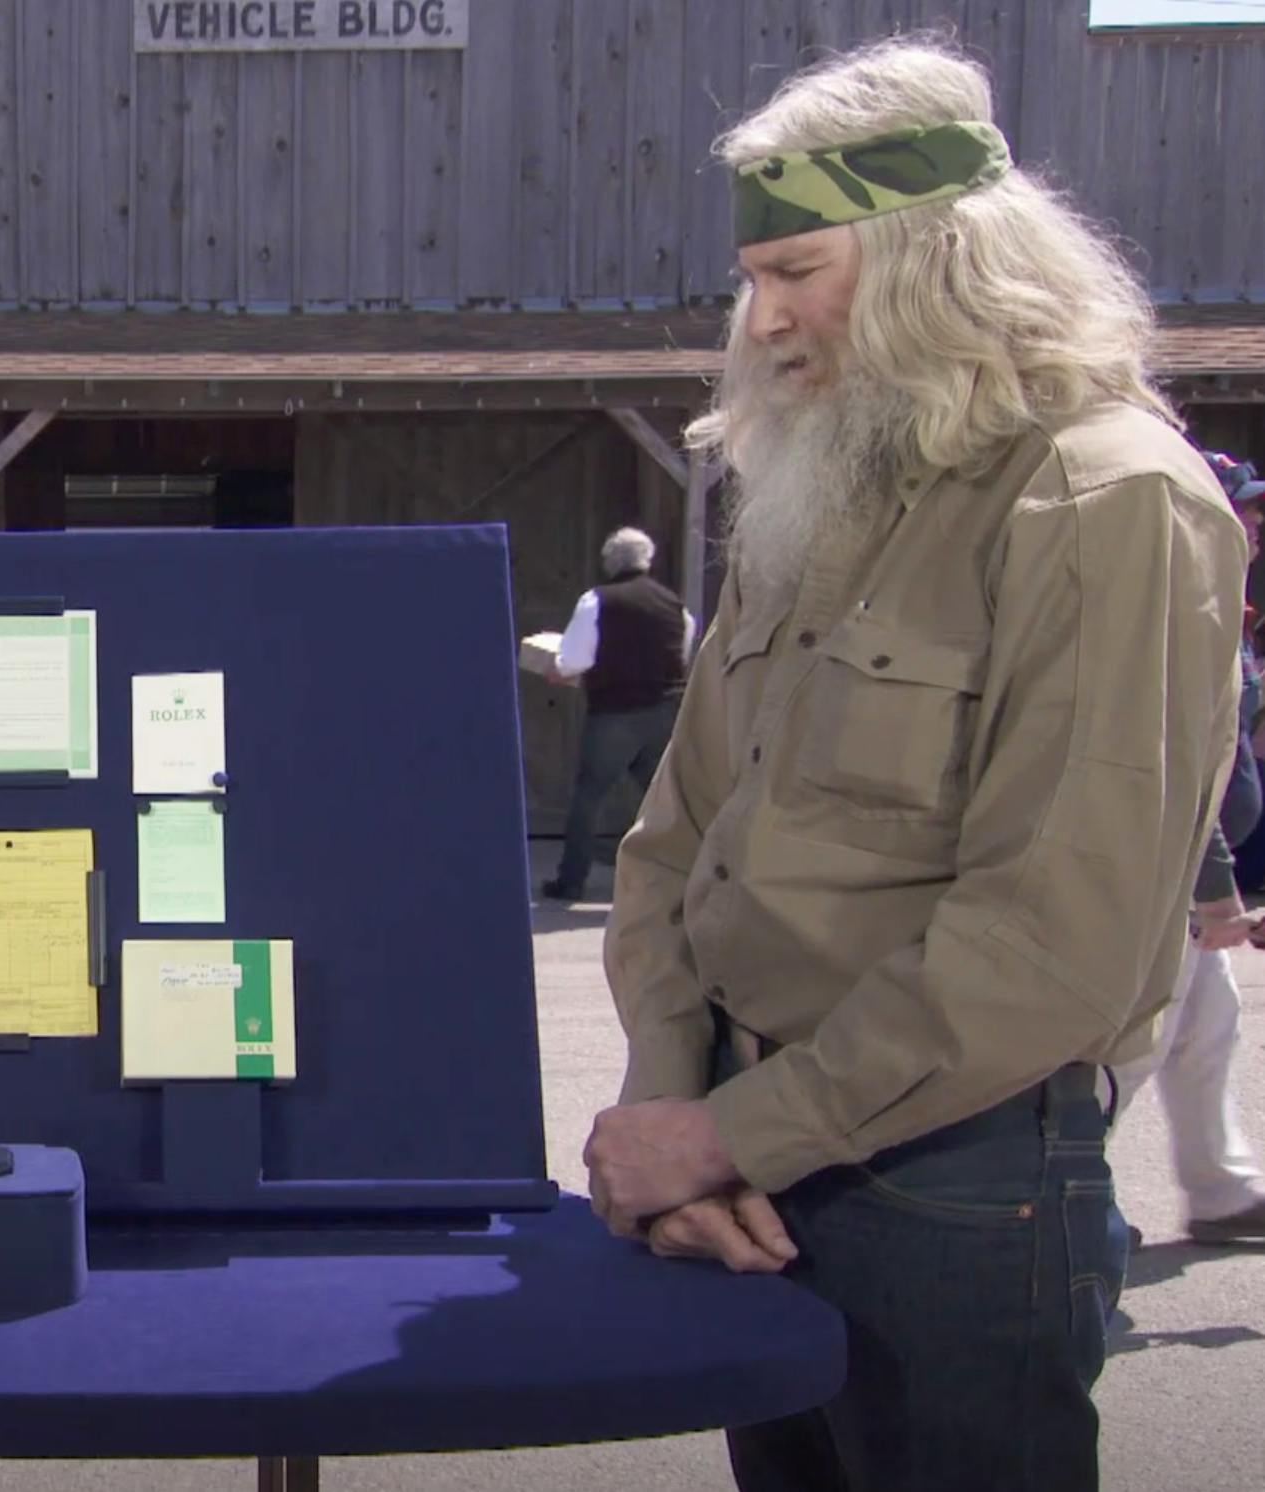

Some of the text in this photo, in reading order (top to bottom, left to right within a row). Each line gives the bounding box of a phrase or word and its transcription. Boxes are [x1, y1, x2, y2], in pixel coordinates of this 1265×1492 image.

[147, 1, 452, 39] VEHICLE BLDG.
[150, 708, 207, 721] ROLEX
